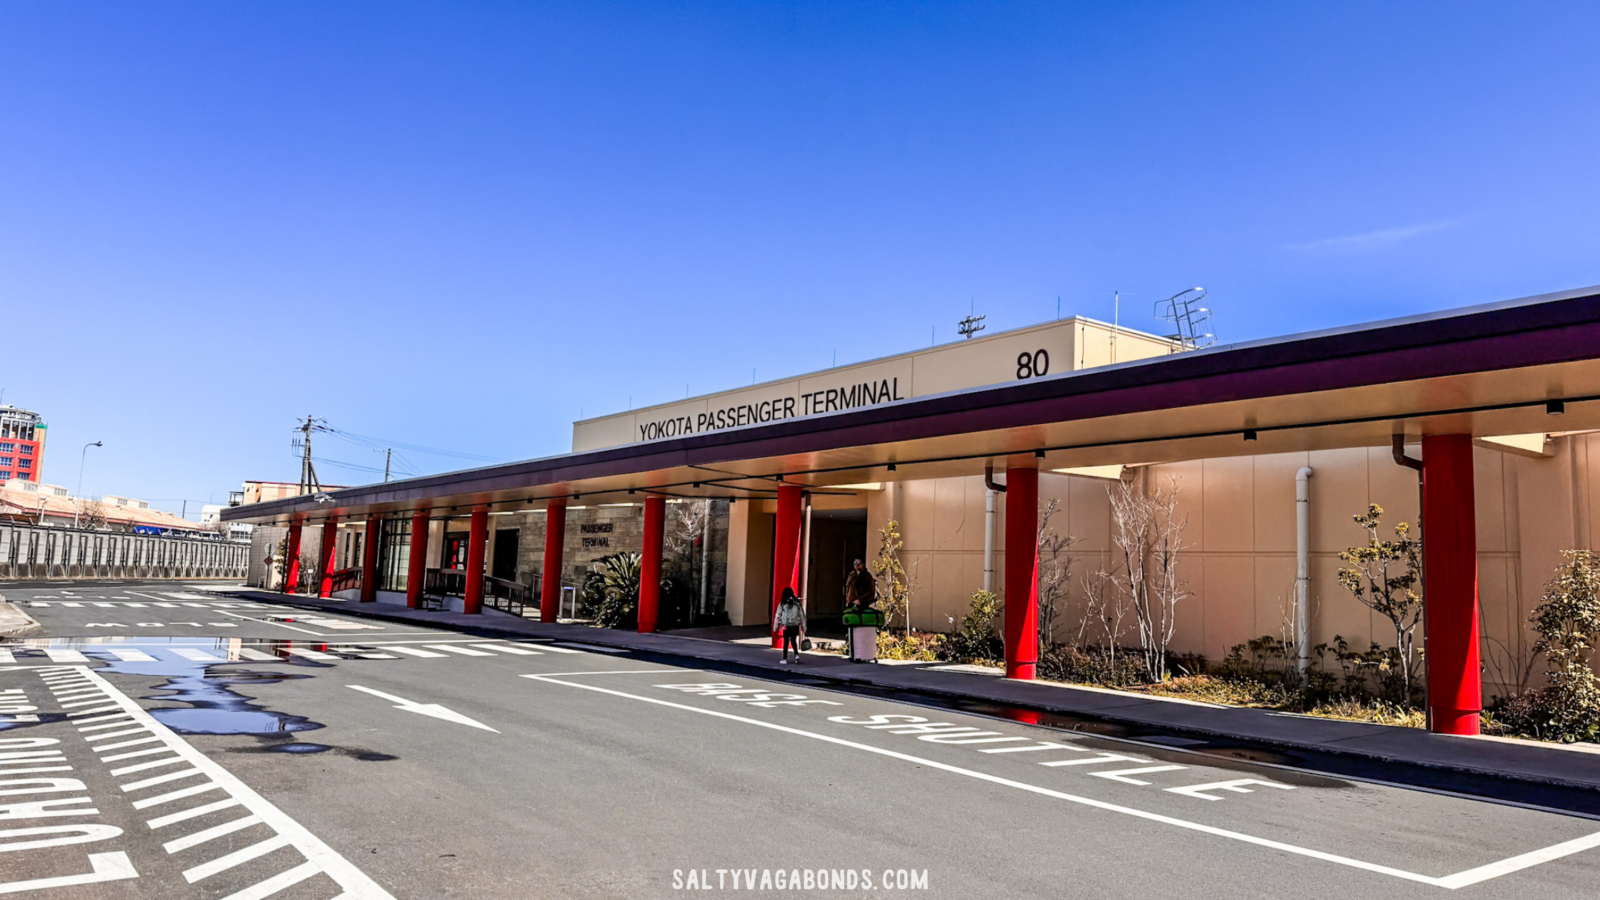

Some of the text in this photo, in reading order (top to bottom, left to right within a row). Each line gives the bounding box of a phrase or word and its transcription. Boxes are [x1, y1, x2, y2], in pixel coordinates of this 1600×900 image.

[1016, 348, 1050, 380] 80
[639, 377, 905, 441] YOKOTA PASSENGER TERMINAL
[580, 523, 614, 534] PASSENGER
[582, 536, 611, 548] TERMINAL
[652, 682, 1297, 801] BASE SHUTTLE
